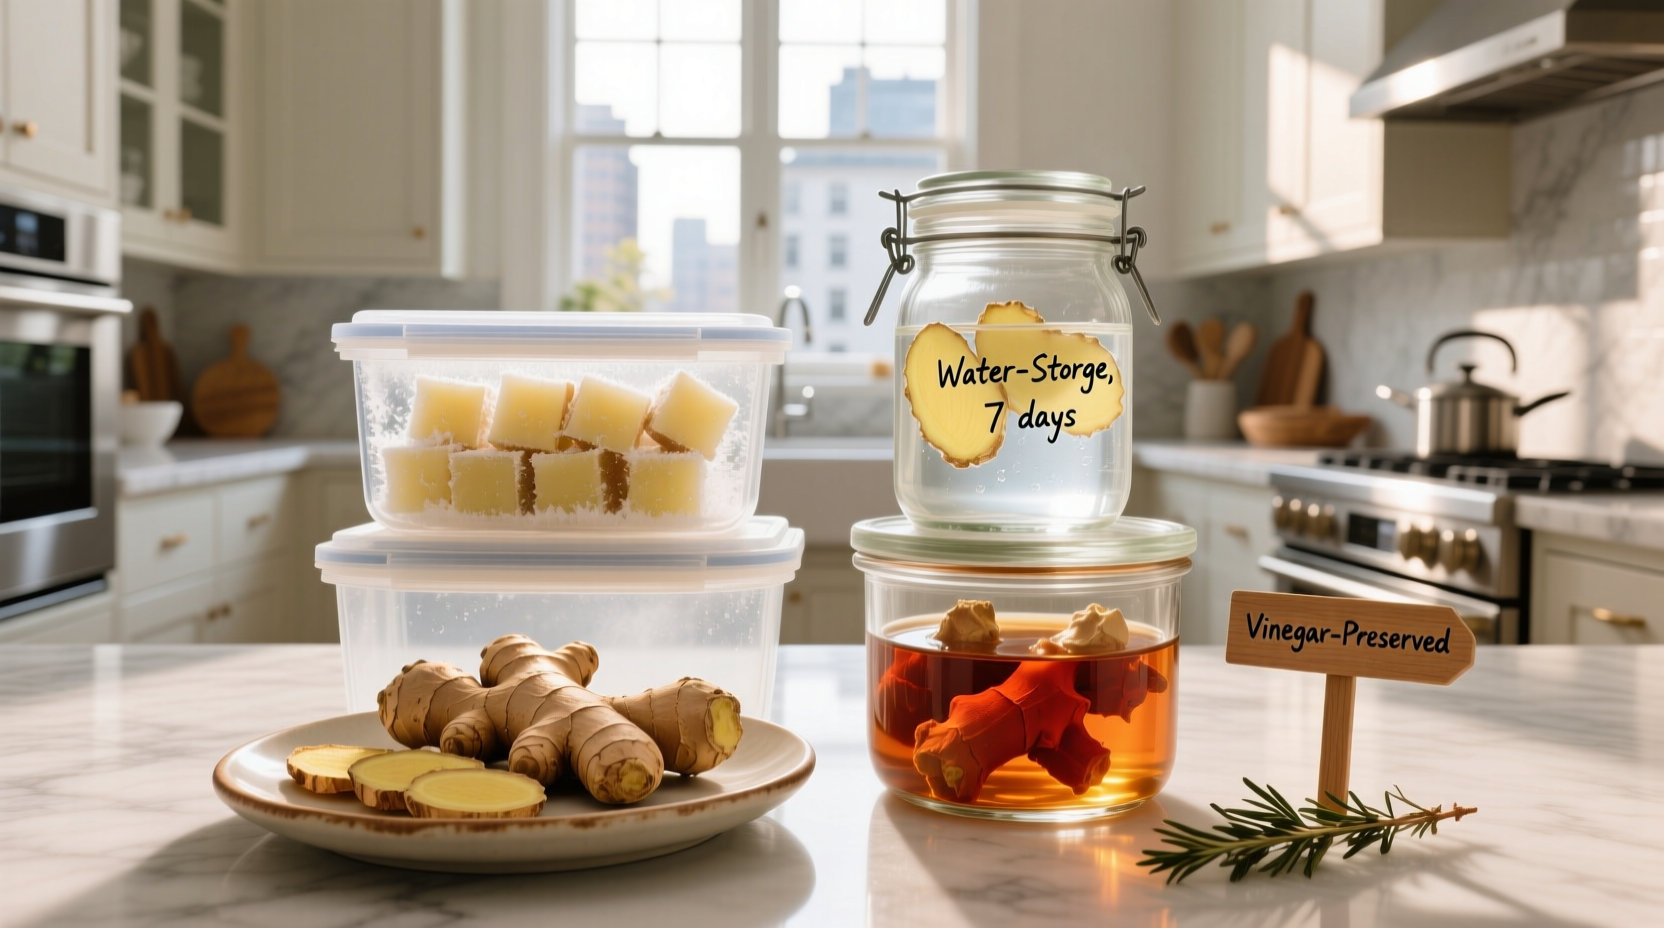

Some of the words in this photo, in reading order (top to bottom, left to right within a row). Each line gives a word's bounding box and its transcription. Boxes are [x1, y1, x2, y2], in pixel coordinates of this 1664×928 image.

[938, 353, 1113, 394] Water-Storge,
[984, 401, 1005, 433] 7
[1018, 399, 1077, 443] days
[1246, 612, 1451, 654] Vinegar-Preserved
